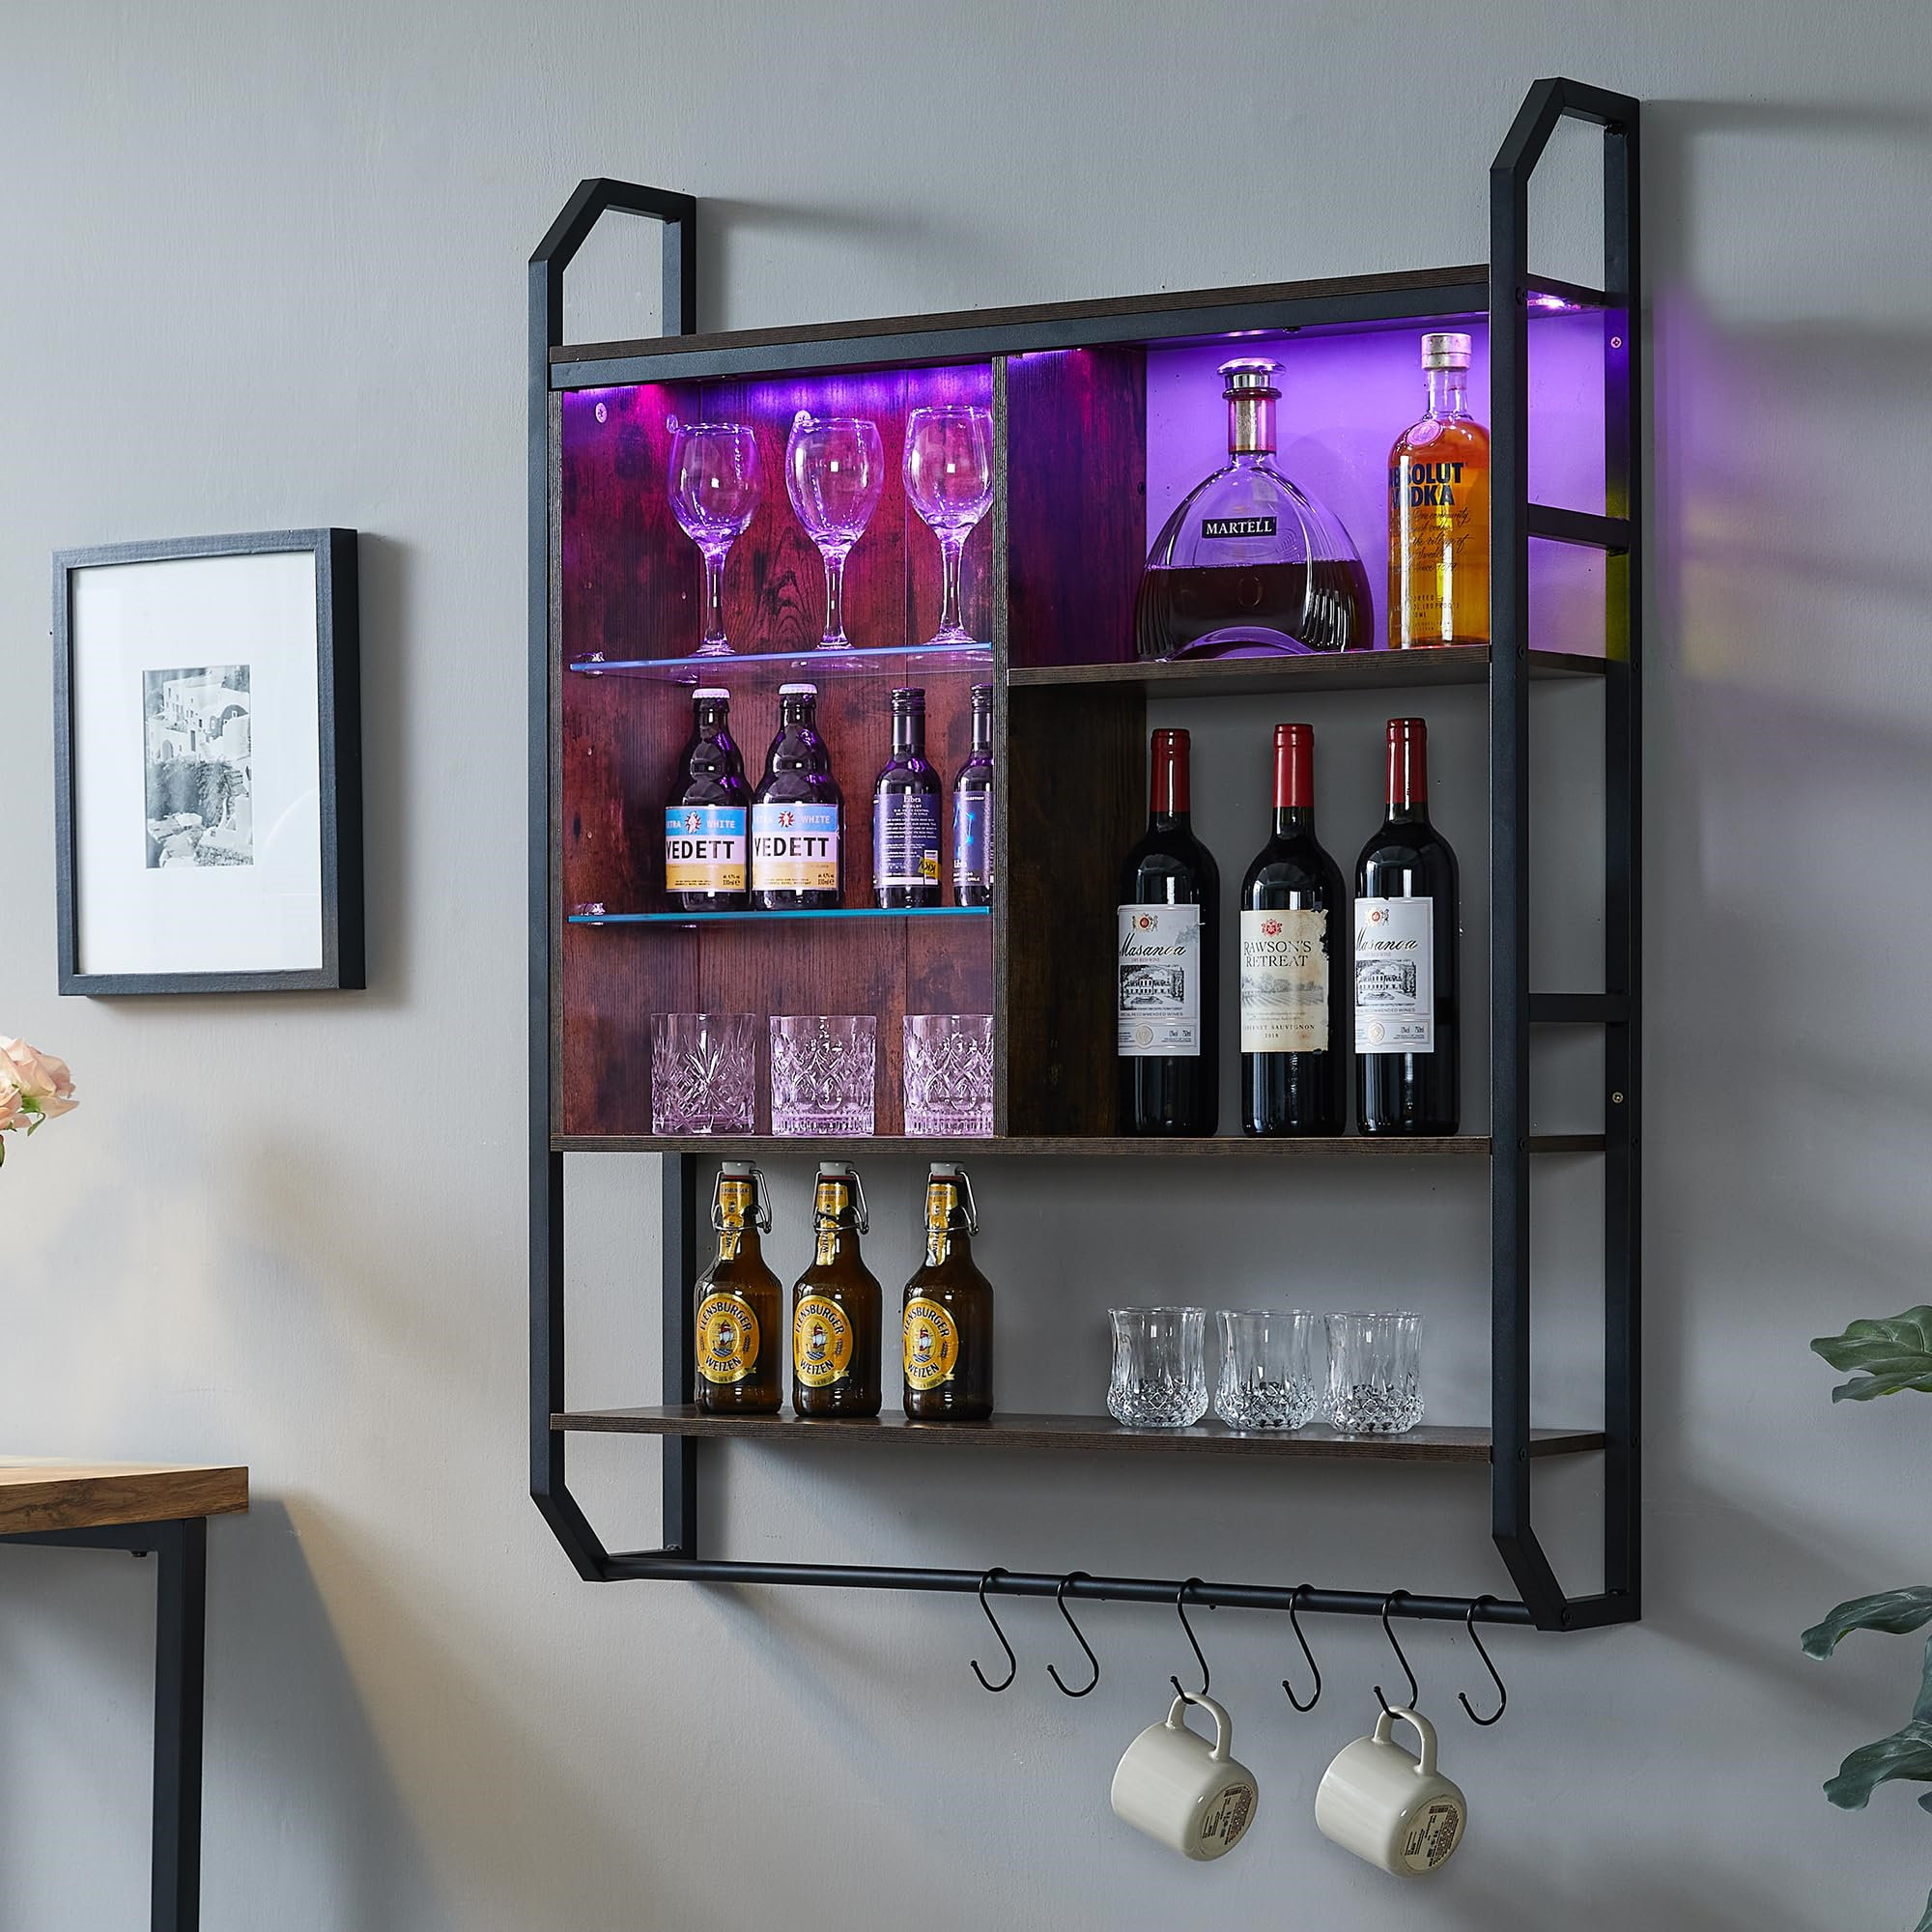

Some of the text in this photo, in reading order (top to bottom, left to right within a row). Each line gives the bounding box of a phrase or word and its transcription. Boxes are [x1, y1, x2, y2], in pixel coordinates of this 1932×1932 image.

[1389, 463, 1464, 487] BOLUT
[1392, 485, 1455, 510] VDKA
[1206, 520, 1273, 536] MARTELL
[706, 819, 735, 829] WHITE
[802, 814, 831, 824] WHITE
[666, 840, 734, 859] VEDETT
[754, 837, 830, 858] VEDETT
[1243, 940, 1313, 956] RAWSON'S
[1246, 954, 1309, 968] RETREAT
[705, 1354, 742, 1372] WEIZEN
[800, 1358, 835, 1376] WEIZEN
[908, 1361, 940, 1378] WEIZEN
